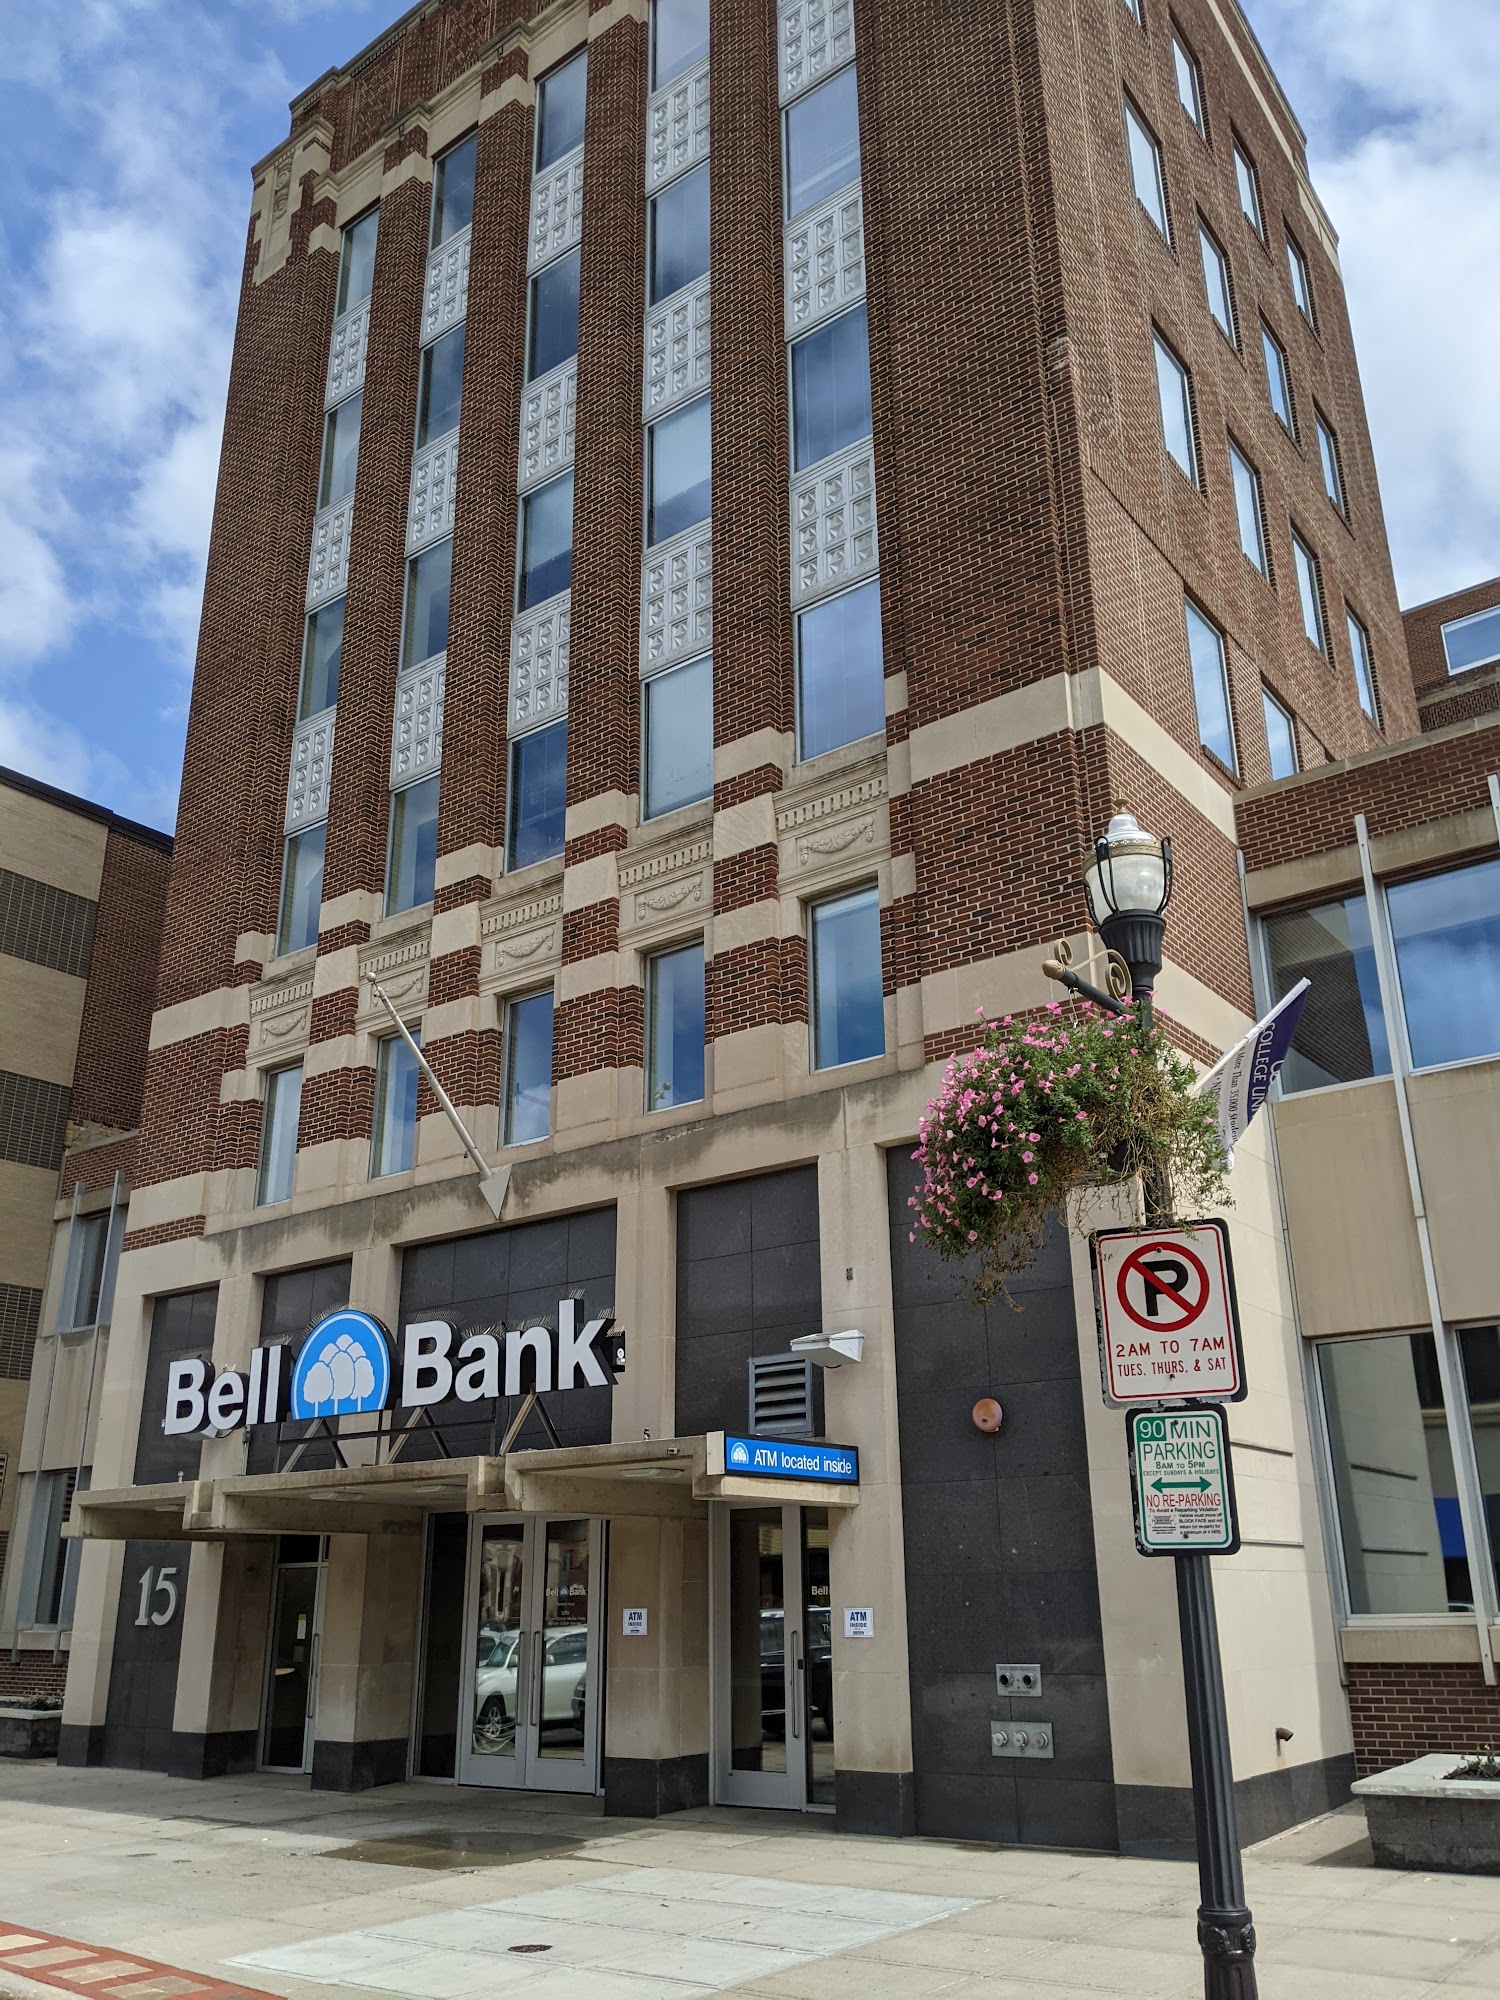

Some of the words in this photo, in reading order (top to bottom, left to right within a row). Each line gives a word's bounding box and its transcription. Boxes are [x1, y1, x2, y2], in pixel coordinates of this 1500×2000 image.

[1254, 1022, 1276, 1083] COLLEGE
[1231, 1070, 1242, 1088] Than
[1250, 1086, 1266, 1117] UNI
[1115, 1342, 1151, 1358] 2AM
[1160, 1340, 1180, 1354] TO
[1189, 1336, 1225, 1352] 7AM
[164, 1345, 285, 1437] Bell
[402, 1298, 612, 1408] Bank
[1117, 1363, 1147, 1377] TUES.
[1151, 1360, 1188, 1375] THURS.
[1193, 1359, 1201, 1372] &
[1207, 1357, 1226, 1371] SAT
[1140, 1420, 1165, 1438] 90
[1170, 1420, 1211, 1439] MIN
[1143, 1441, 1216, 1461] PARKING
[754, 1449, 778, 1467] ATM
[781, 1452, 820, 1471] located
[823, 1456, 852, 1474] inside
[1155, 1461, 1173, 1469] 8AM
[1187, 1460, 1206, 1468] 5PM
[1146, 1494, 1160, 1507] NO
[1162, 1493, 1221, 1507] RE-PARKING
[135, 1566, 180, 1627] 15
[545, 1587, 559, 1597] Bell
[569, 1587, 587, 1596] Bank
[811, 1586, 829, 1596] Bell
[628, 1611, 643, 1621] ATM
[849, 1611, 868, 1621] ATM
